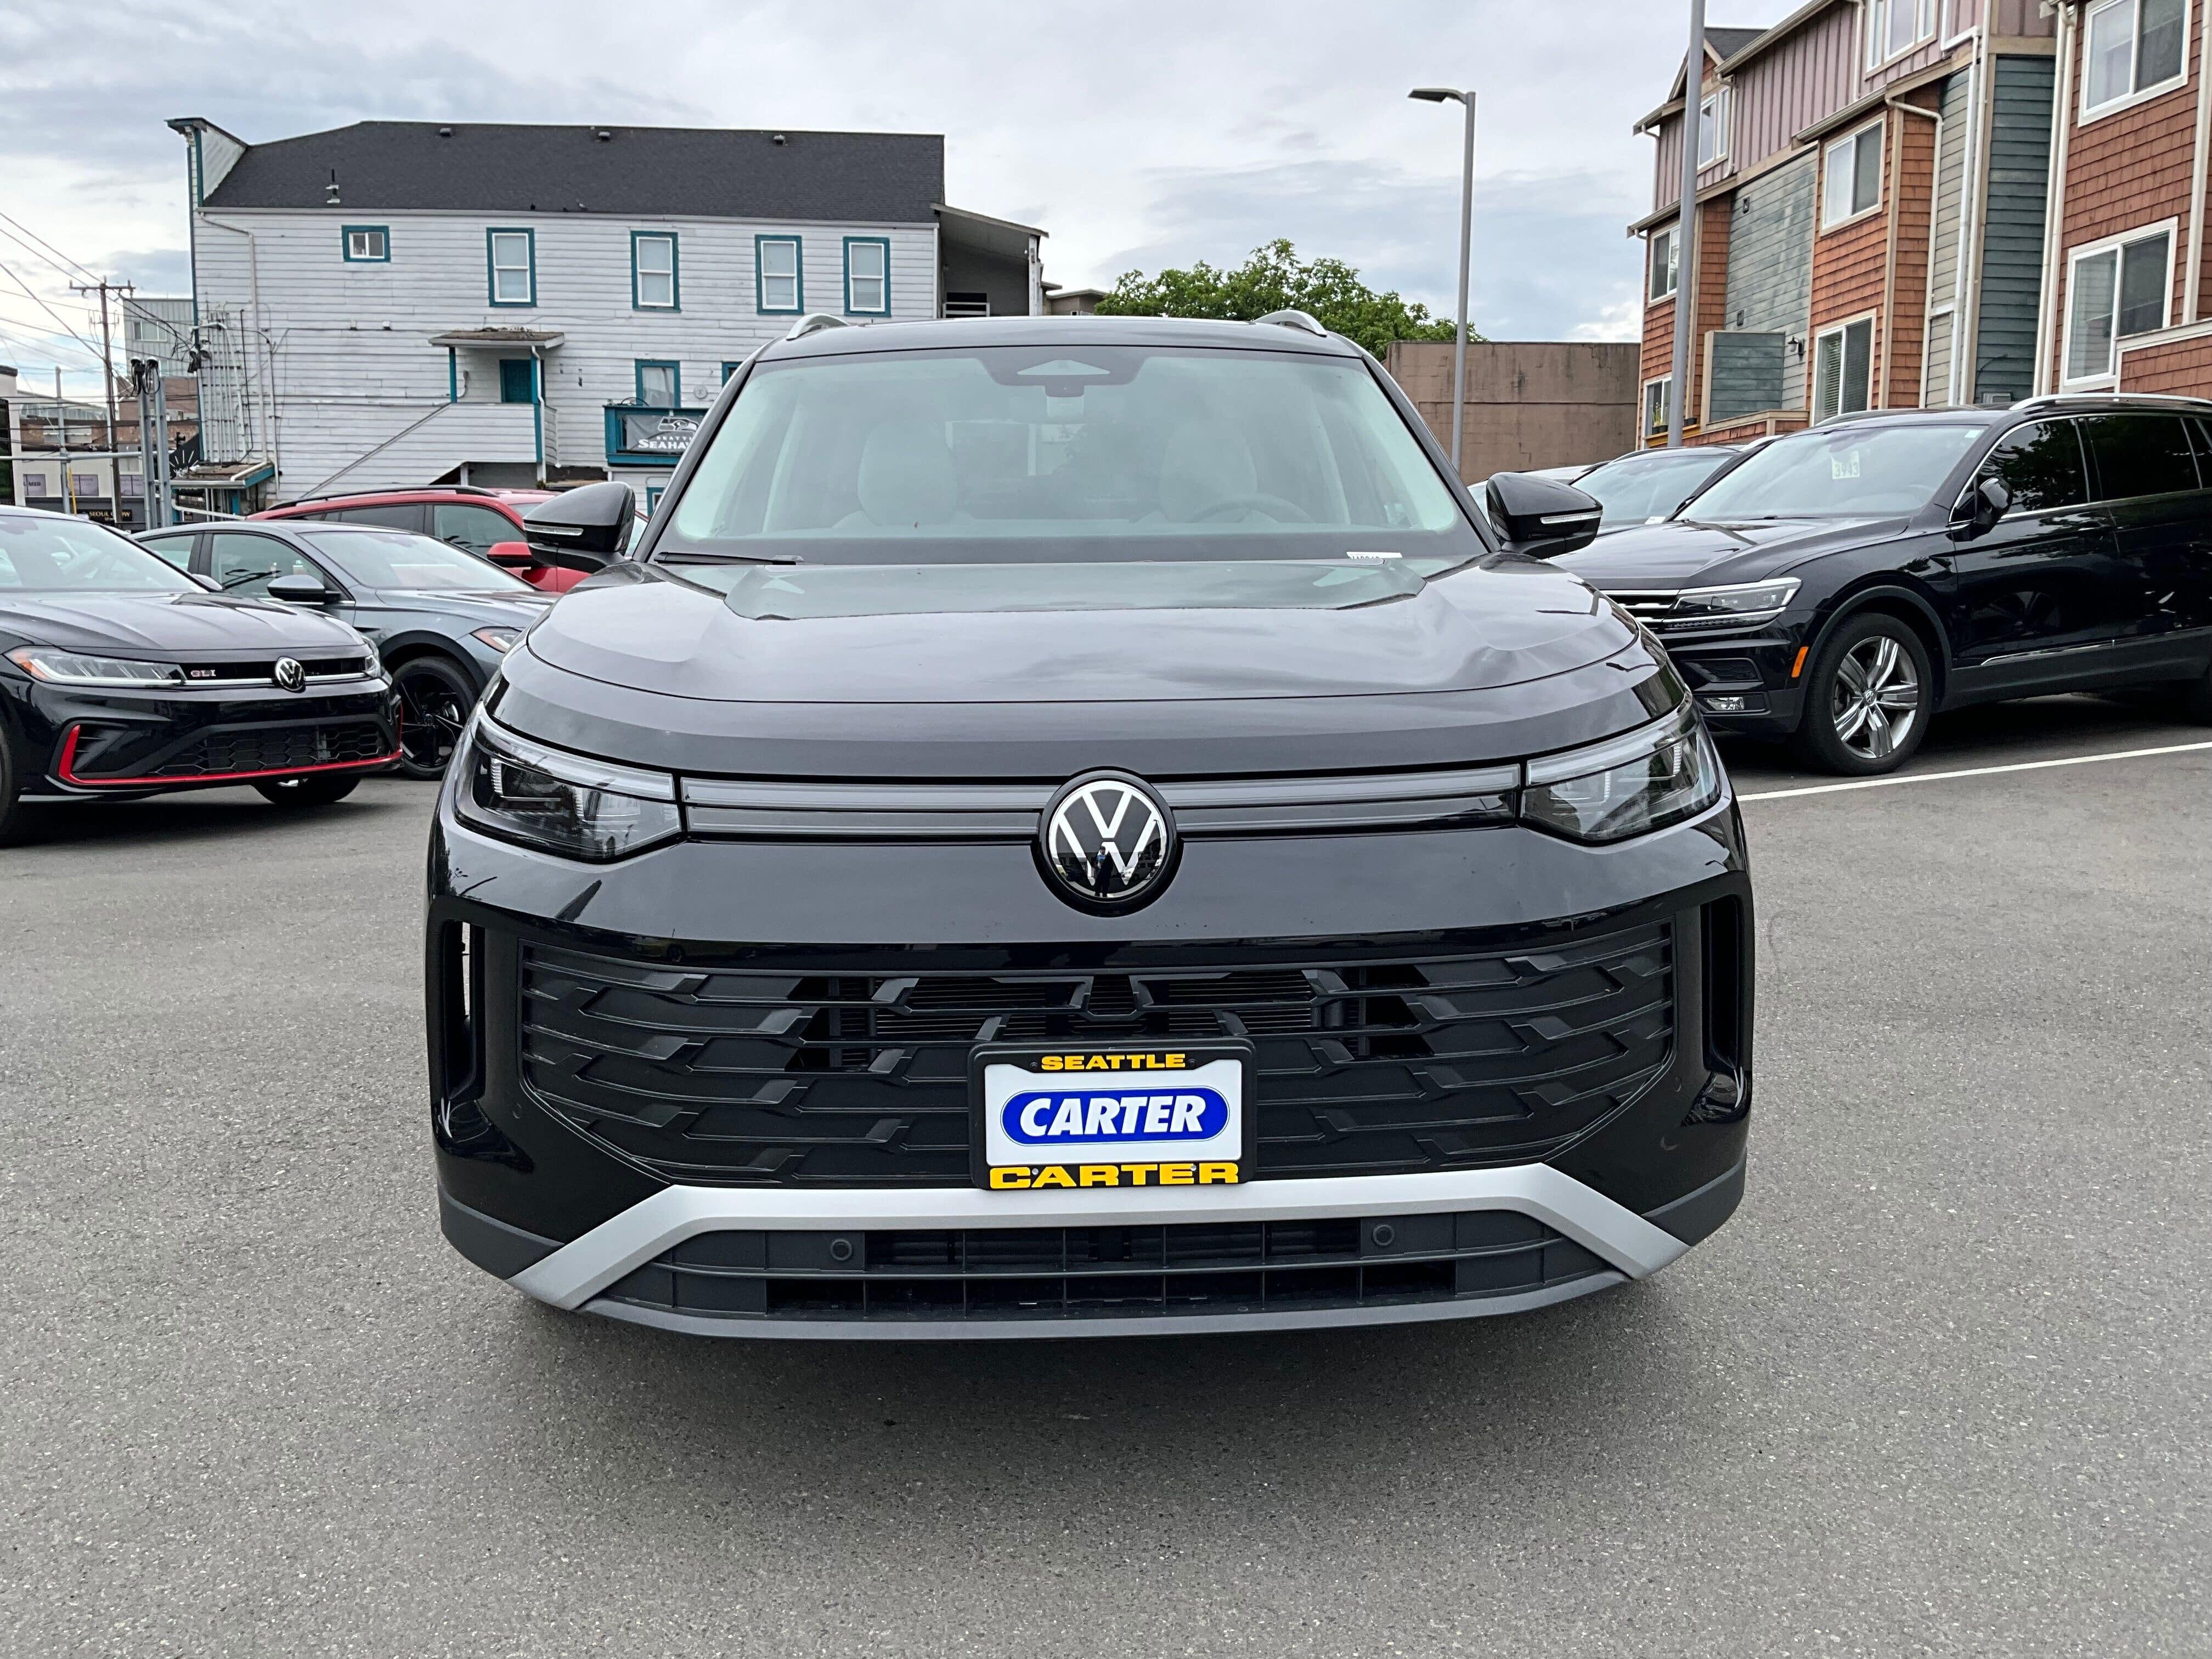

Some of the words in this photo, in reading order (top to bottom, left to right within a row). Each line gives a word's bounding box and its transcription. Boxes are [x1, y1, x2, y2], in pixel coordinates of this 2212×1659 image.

[638, 438, 689, 449] SEAHA
[1049, 780, 1167, 898] VW
[1041, 1053, 1186, 1070] SEATTLE
[1020, 1095, 1206, 1137] CARTER
[989, 1163, 1238, 1189] CARTER
